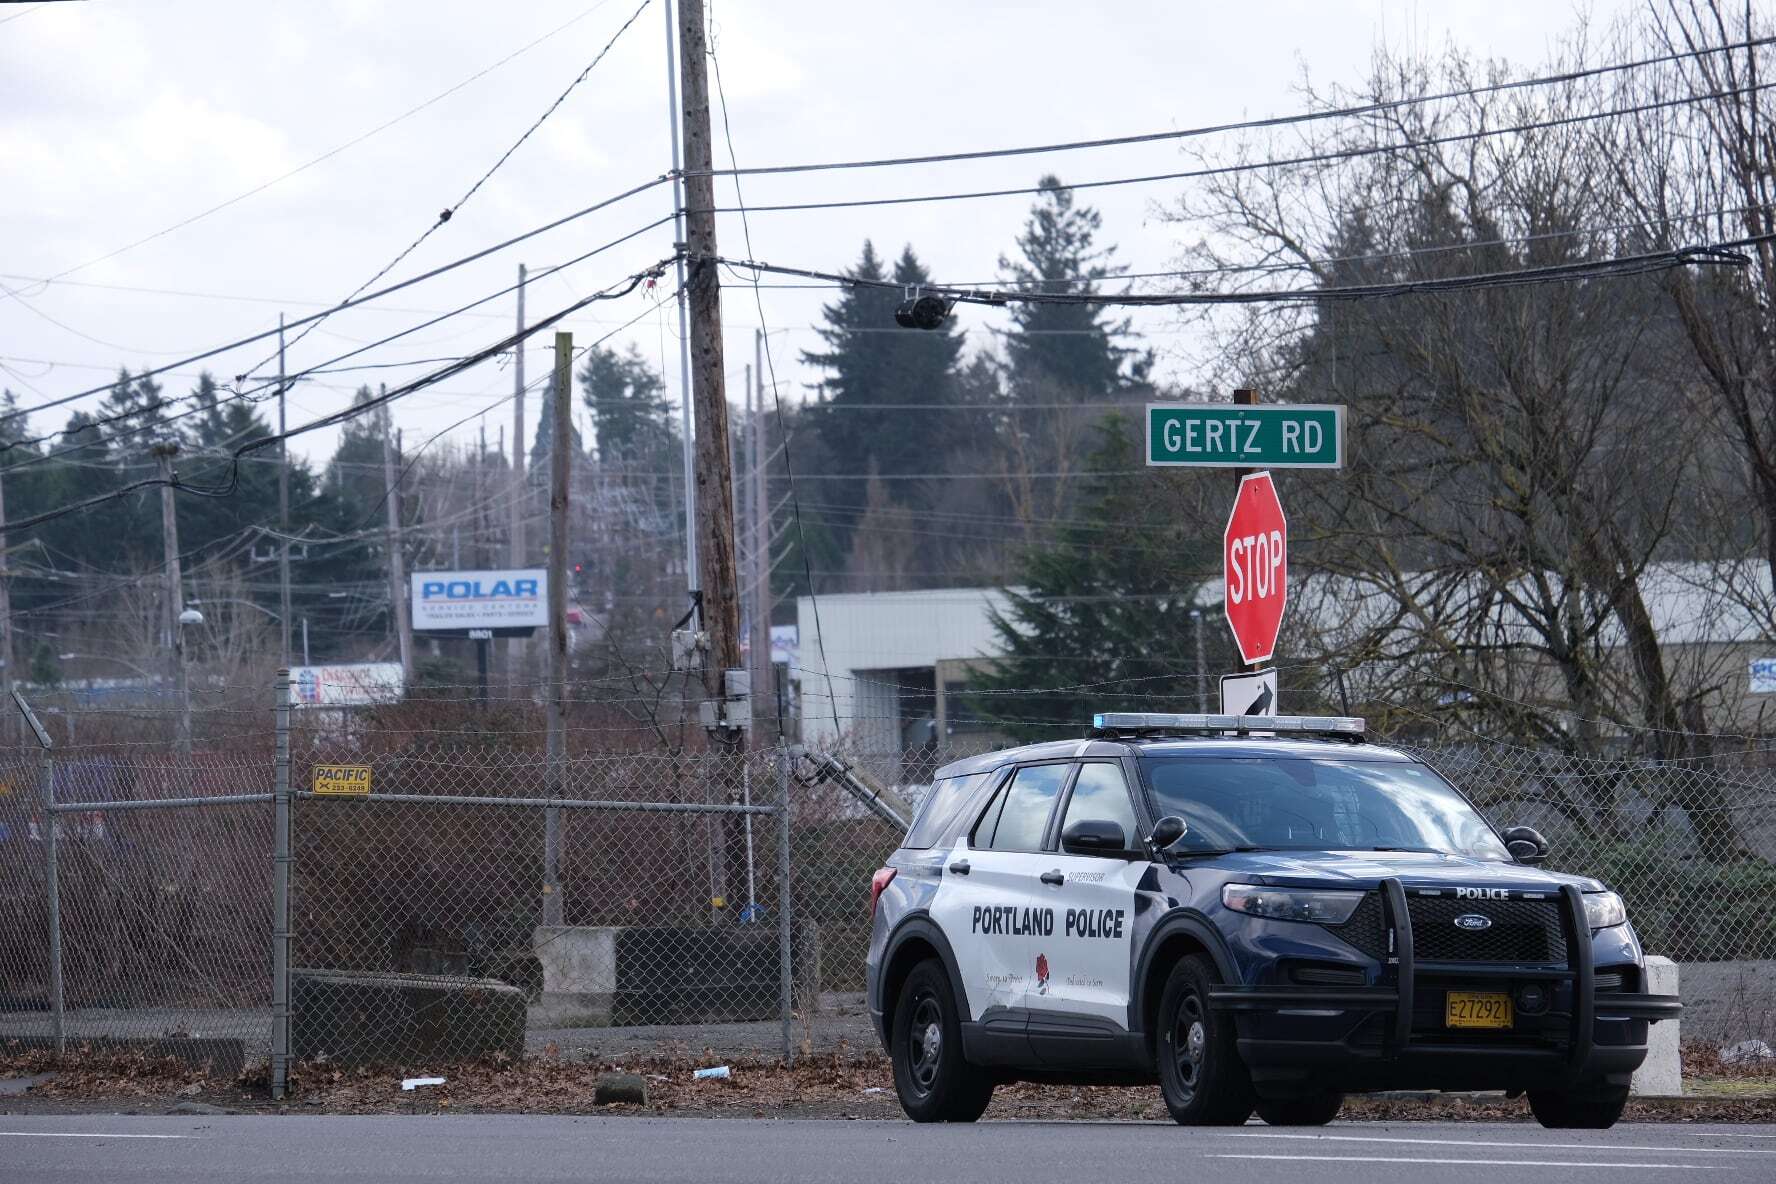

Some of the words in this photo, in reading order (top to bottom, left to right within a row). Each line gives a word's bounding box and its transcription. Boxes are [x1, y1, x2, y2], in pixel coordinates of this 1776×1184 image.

[1163, 418, 1262, 453] GERTZ
[1282, 420, 1323, 453] RD
[1230, 530, 1283, 604] STOP
[422, 579, 538, 599] POLAR
[468, 630, 493, 639] 8801
[315, 768, 368, 781] PACIFIC
[1456, 887, 1509, 900] POLICE
[972, 906, 1054, 937] PORTLAND
[1065, 908, 1125, 939] POLICE
[1463, 917, 1483, 927] Ford
[1449, 999, 1509, 1020] E272921
